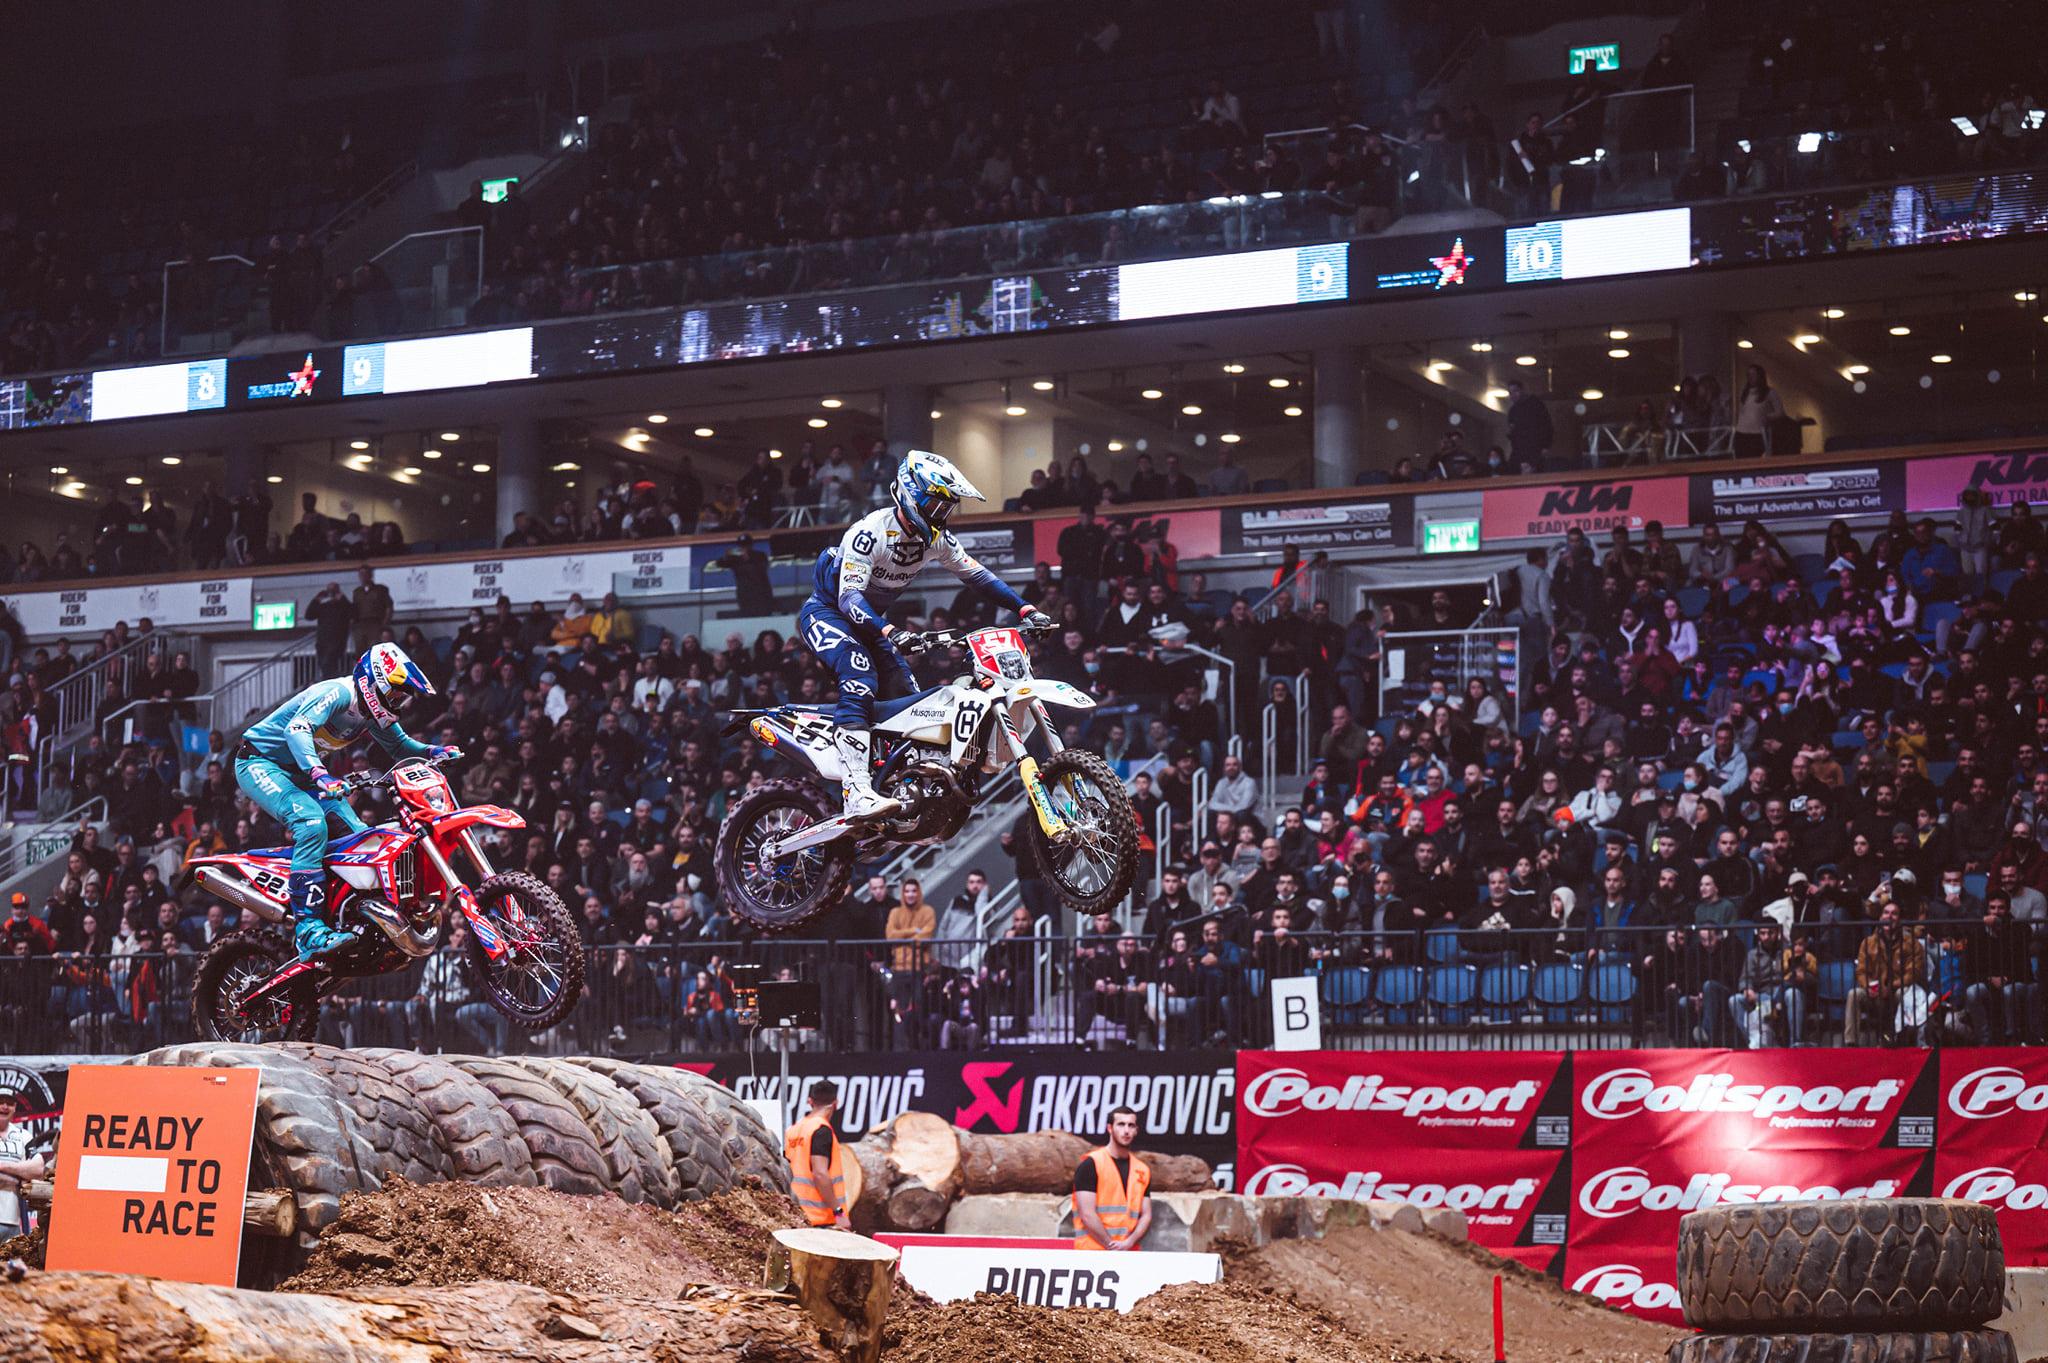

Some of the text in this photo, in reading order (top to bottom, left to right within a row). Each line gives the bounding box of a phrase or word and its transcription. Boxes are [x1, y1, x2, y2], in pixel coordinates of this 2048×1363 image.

[1512, 240, 1549, 271] 10
[1310, 262, 1333, 291] 9
[352, 357, 371, 385] 9
[197, 372, 216, 400] 8
[1538, 484, 1633, 516] KTM
[1713, 495, 1881, 516] The Best Adventure You Can Get
[1527, 515, 1628, 535] READY TO RACE
[1242, 528, 1392, 547] The Best Adventure You Can Get
[632, 552, 663, 565] RIDERS
[473, 562, 504, 575] RIDERS
[638, 564, 656, 577] FOR
[201, 582, 228, 594] RIDERS
[480, 575, 496, 587] FOR
[632, 577, 663, 589] RIDERS
[60, 592, 87, 603] RIDERS
[206, 594, 221, 605] FOR
[472, 587, 503, 600] RIDERS
[66, 604, 81, 615] FOR
[200, 605, 227, 617] RIDERS
[59, 616, 86, 627] RIDERS
[983, 630, 1012, 650] 57
[359, 676, 387, 720] Red Bull
[911, 707, 946, 718] Husqvarna
[406, 769, 431, 781] 22
[254, 871, 285, 894] 22
[1284, 995, 1309, 1031] B
[1244, 1068, 1537, 1117] Polisport
[1582, 1068, 1899, 1119] Polisport
[1418, 1116, 1516, 1127] Performance Plastics
[1769, 1115, 1877, 1129] Performance Plastics
[83, 1114, 203, 1151] READY
[177, 1158, 221, 1195] TO
[122, 1198, 217, 1237] RACE
[985, 1267, 1120, 1310] RIDERS
